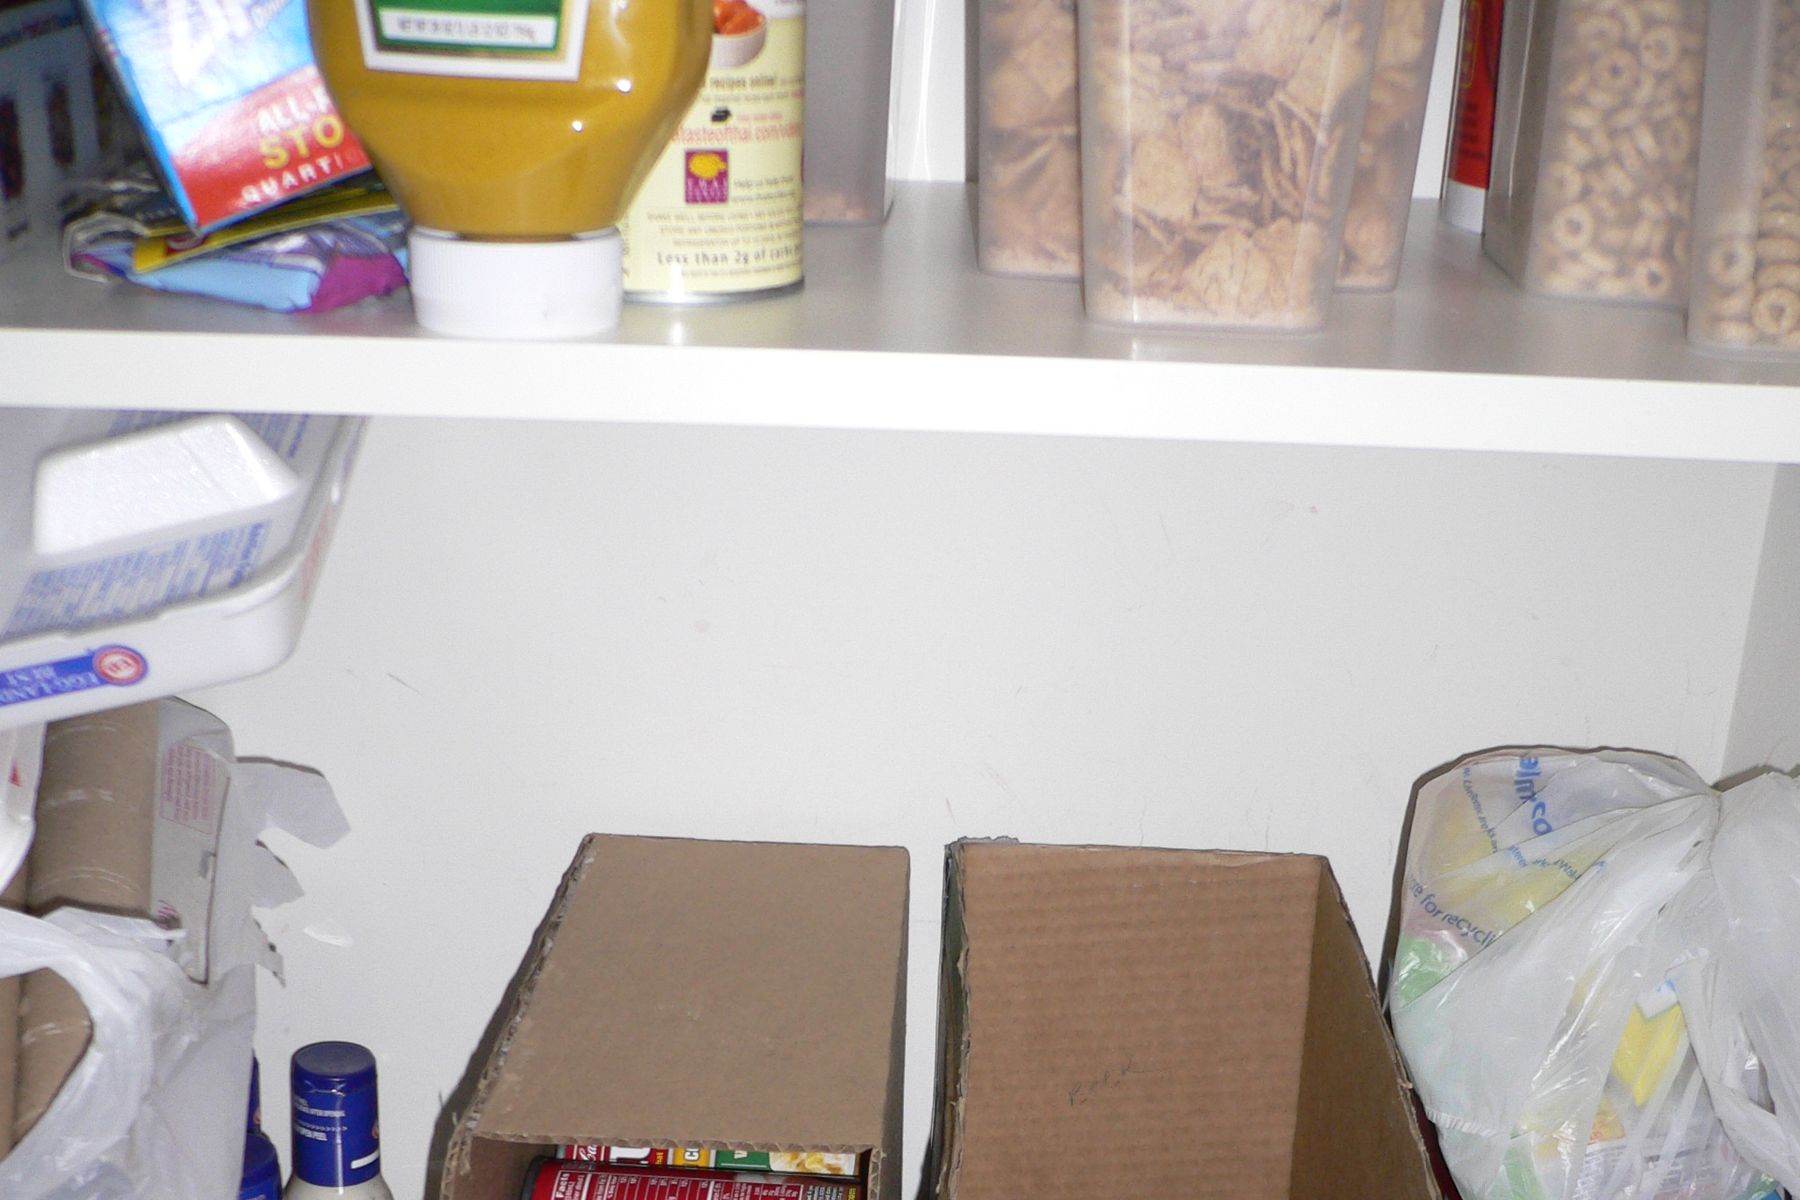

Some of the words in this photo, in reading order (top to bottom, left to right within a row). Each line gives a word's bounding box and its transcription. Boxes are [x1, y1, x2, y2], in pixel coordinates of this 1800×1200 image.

[656, 252, 688, 265] Less
[694, 251, 728, 264] than
[1420, 893, 1445, 917] for
[1442, 913, 1496, 948] recycli
[556, 1173, 570, 1198] Facts
